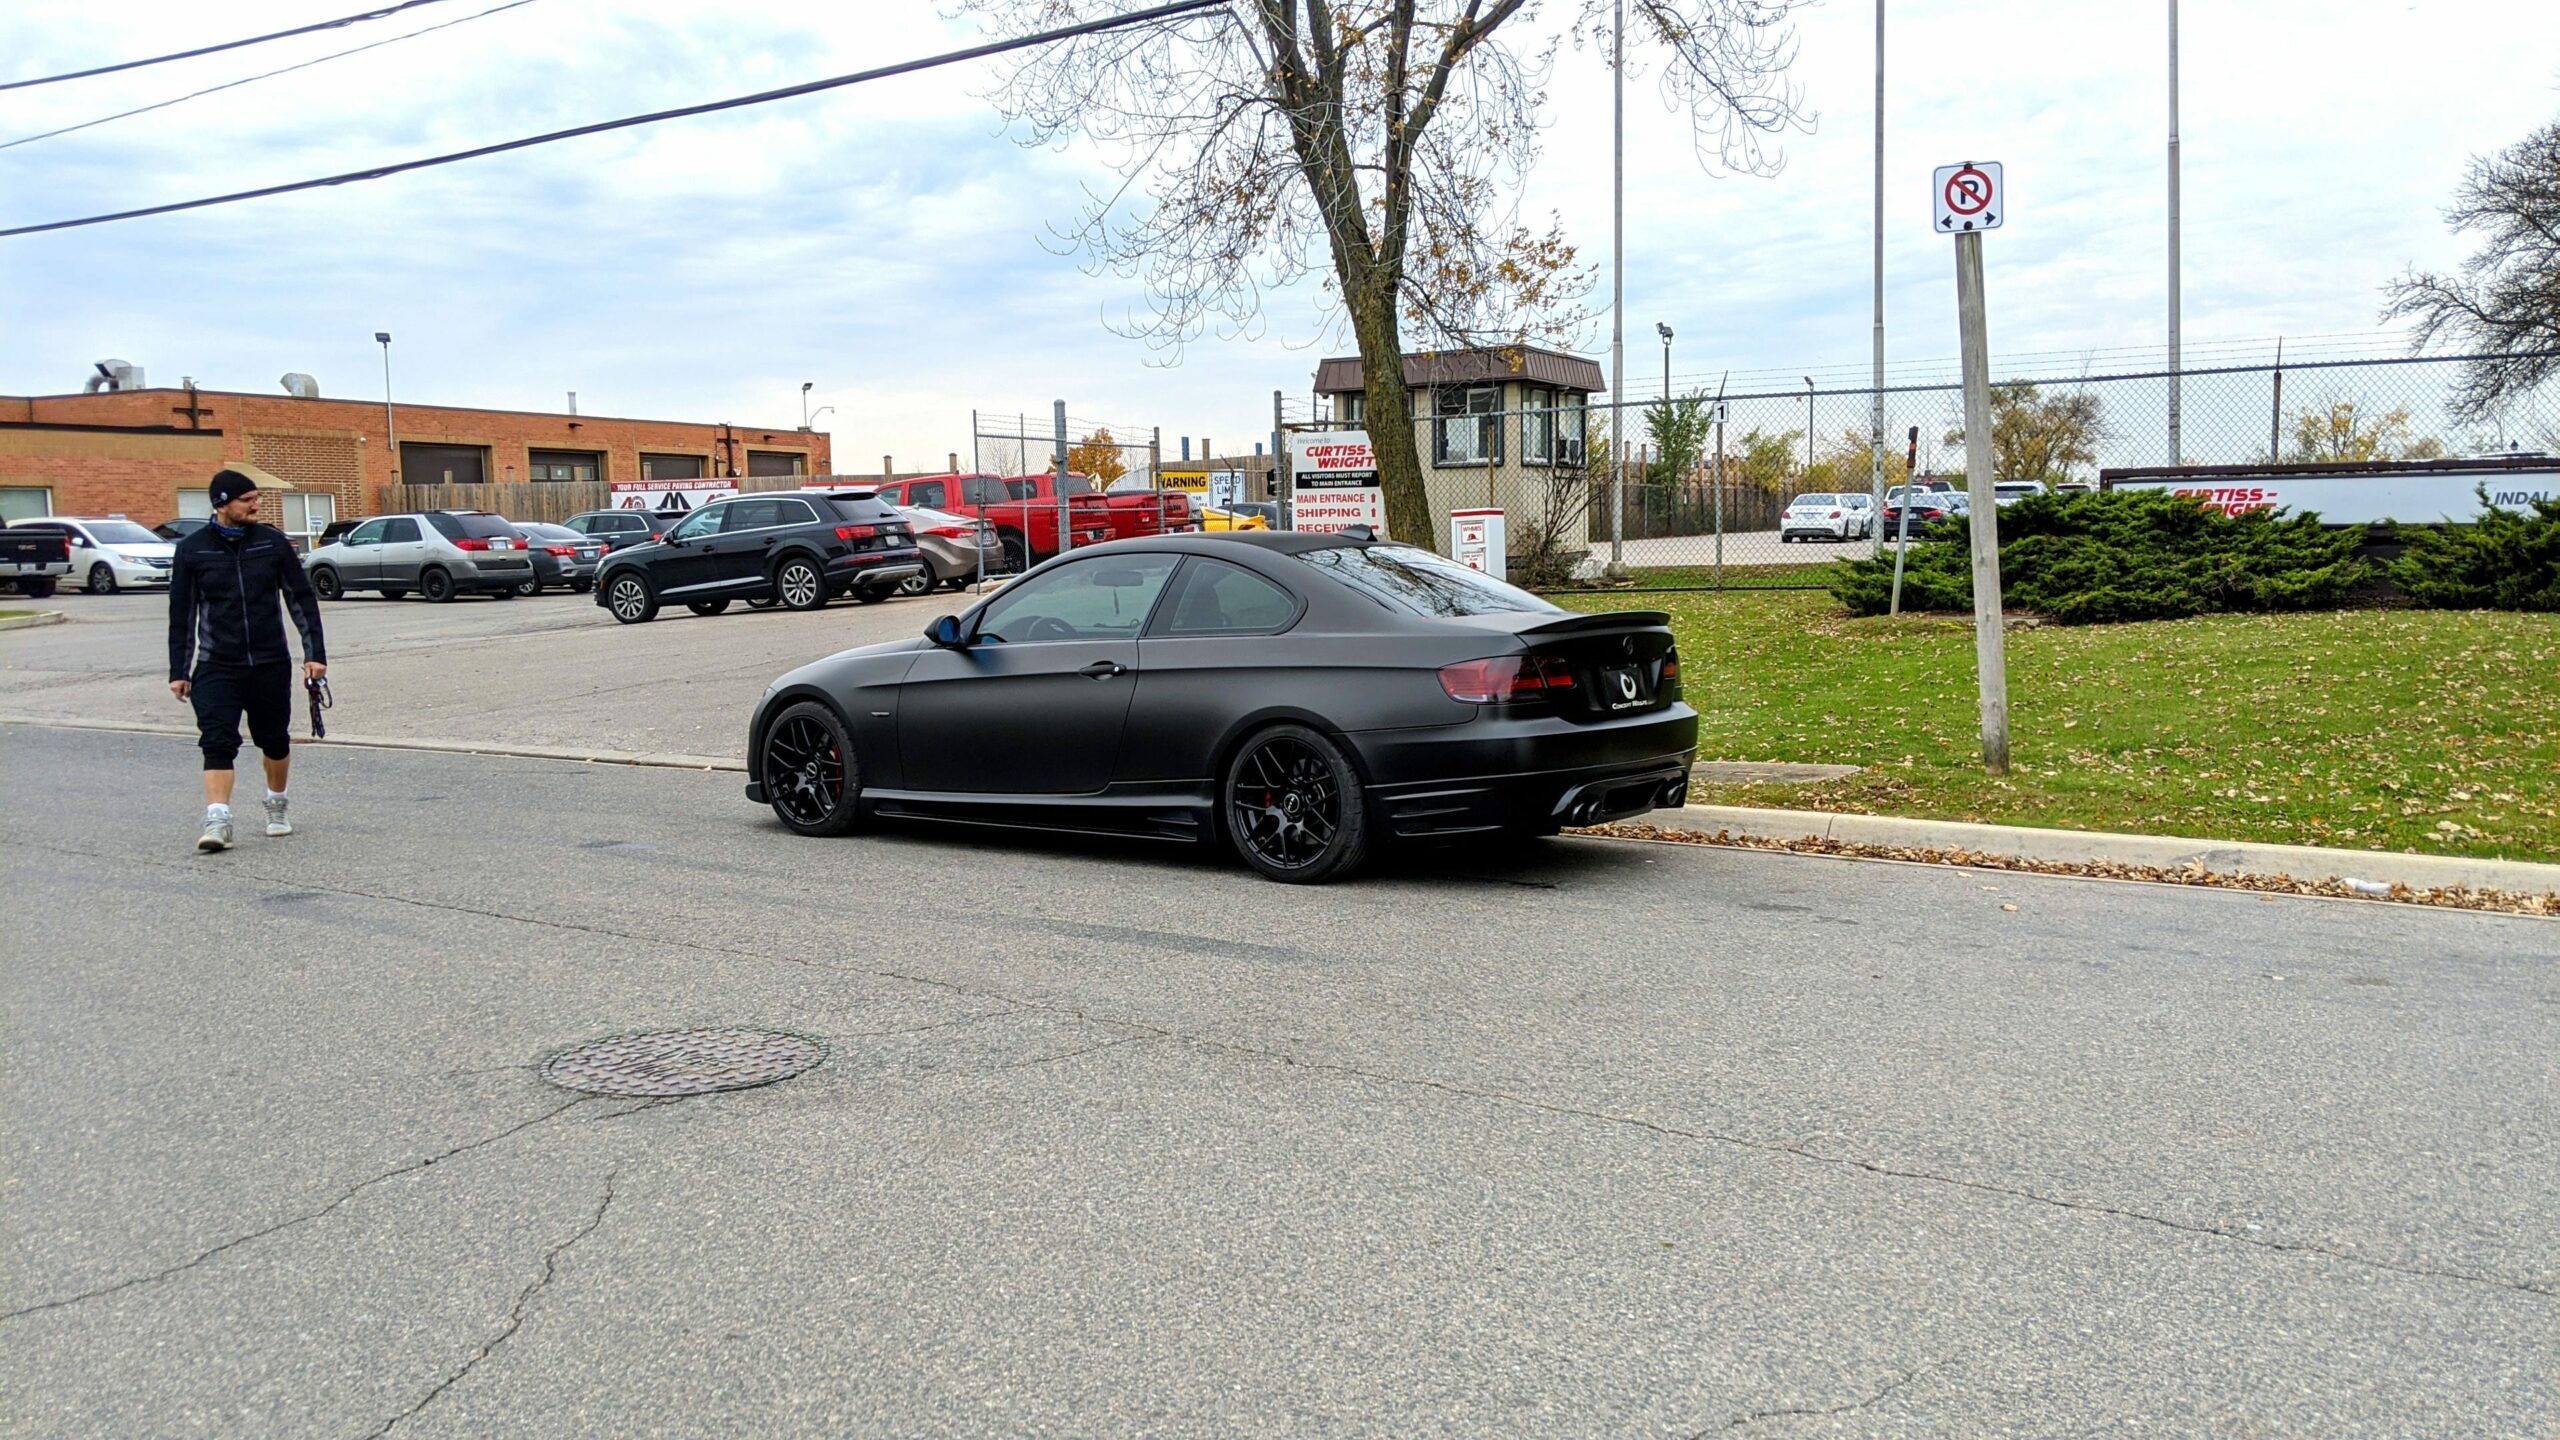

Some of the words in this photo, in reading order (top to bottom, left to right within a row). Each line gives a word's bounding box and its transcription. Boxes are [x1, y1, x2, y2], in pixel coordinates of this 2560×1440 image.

[1717, 405, 1724, 420] 1
[1318, 456, 1377, 468] WRIGHT
[633, 483, 646, 491] FULL
[648, 482, 671, 490] SERVICE
[672, 481, 693, 489] PAVING
[694, 480, 731, 488] CONTRACTOR
[1214, 476, 1241, 485] SPED
[1217, 485, 1238, 494] LIMT
[1296, 494, 1317, 503] MAIN
[1319, 493, 1365, 503] ENTRANCE
[1296, 508, 1361, 518] SHIPPING
